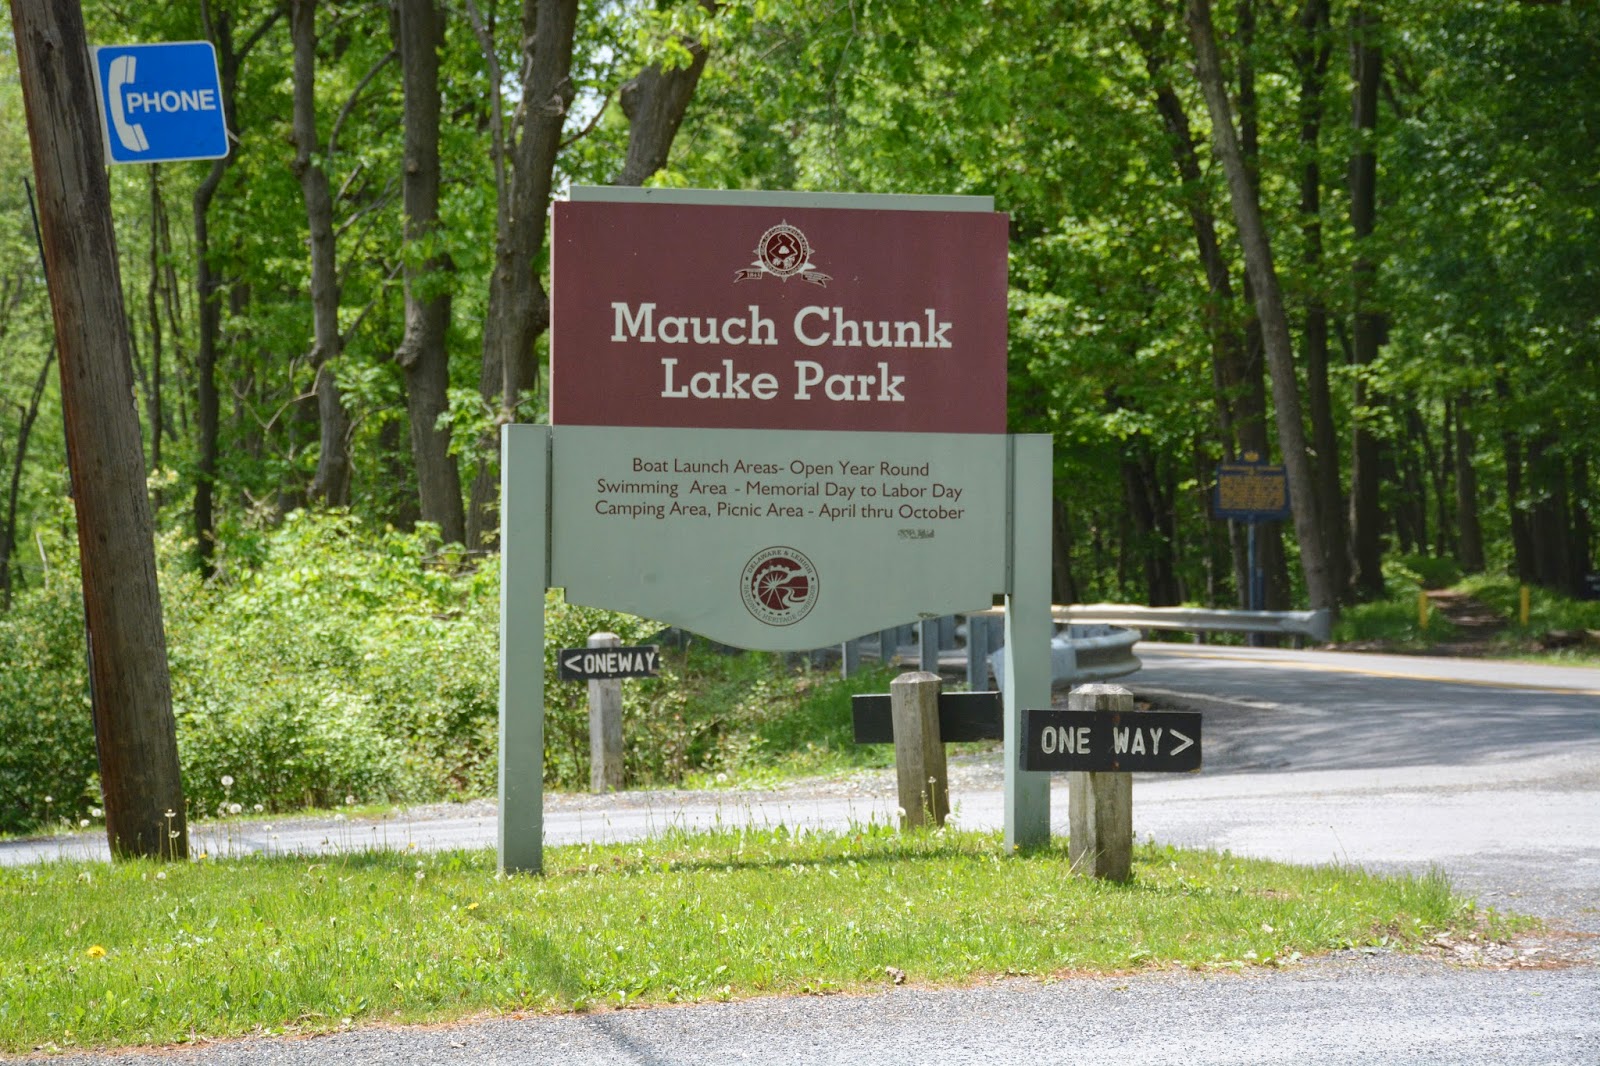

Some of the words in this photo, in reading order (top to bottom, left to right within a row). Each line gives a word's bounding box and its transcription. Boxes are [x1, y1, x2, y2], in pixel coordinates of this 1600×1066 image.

[126, 89, 216, 114] PHONE
[611, 302, 778, 345] Mauch
[793, 305, 952, 348] Chunk
[661, 358, 779, 400] Lake
[793, 360, 905, 402] Park
[633, 457, 669, 473] Boat
[674, 458, 729, 474] Launch
[790, 460, 833, 478] Open
[839, 461, 875, 476] Year
[880, 461, 930, 477] Round
[597, 478, 679, 498] Swimming
[689, 480, 727, 495] Area
[746, 481, 820, 496] Memorial
[825, 482, 856, 500] Day
[860, 485, 877, 497] to
[882, 482, 928, 498] Labor
[932, 483, 963, 502] Day
[595, 500, 665, 520] Camping
[669, 501, 711, 518] Area,
[717, 502, 762, 517] Picnic
[766, 503, 804, 518] Area
[819, 503, 856, 522] April
[861, 504, 893, 519] thru
[899, 504, 965, 520] October
[748, 550, 782, 573] DELAWARE
[791, 552, 813, 574] LEHIGH
[1041, 726, 1091, 754] ONE
[1113, 726, 1163, 756] WAY
